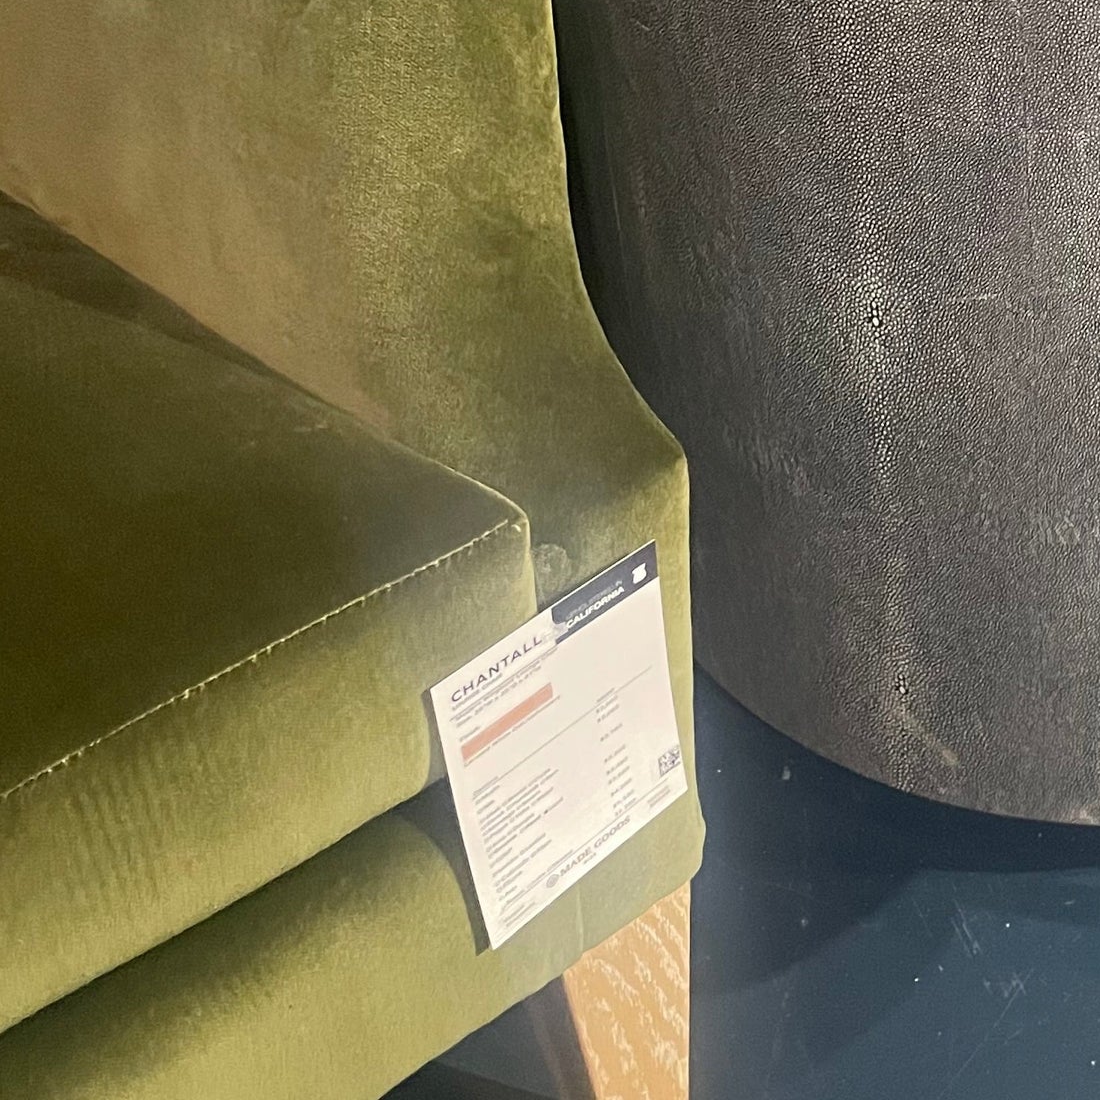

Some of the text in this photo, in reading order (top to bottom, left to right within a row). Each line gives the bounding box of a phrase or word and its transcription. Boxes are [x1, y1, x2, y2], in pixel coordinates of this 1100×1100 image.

[566, 586, 625, 629] CALIFORNIA
[451, 636, 543, 702] CHANTALL
[560, 845, 592, 877] MADE
[594, 816, 631, 849] GOODS
